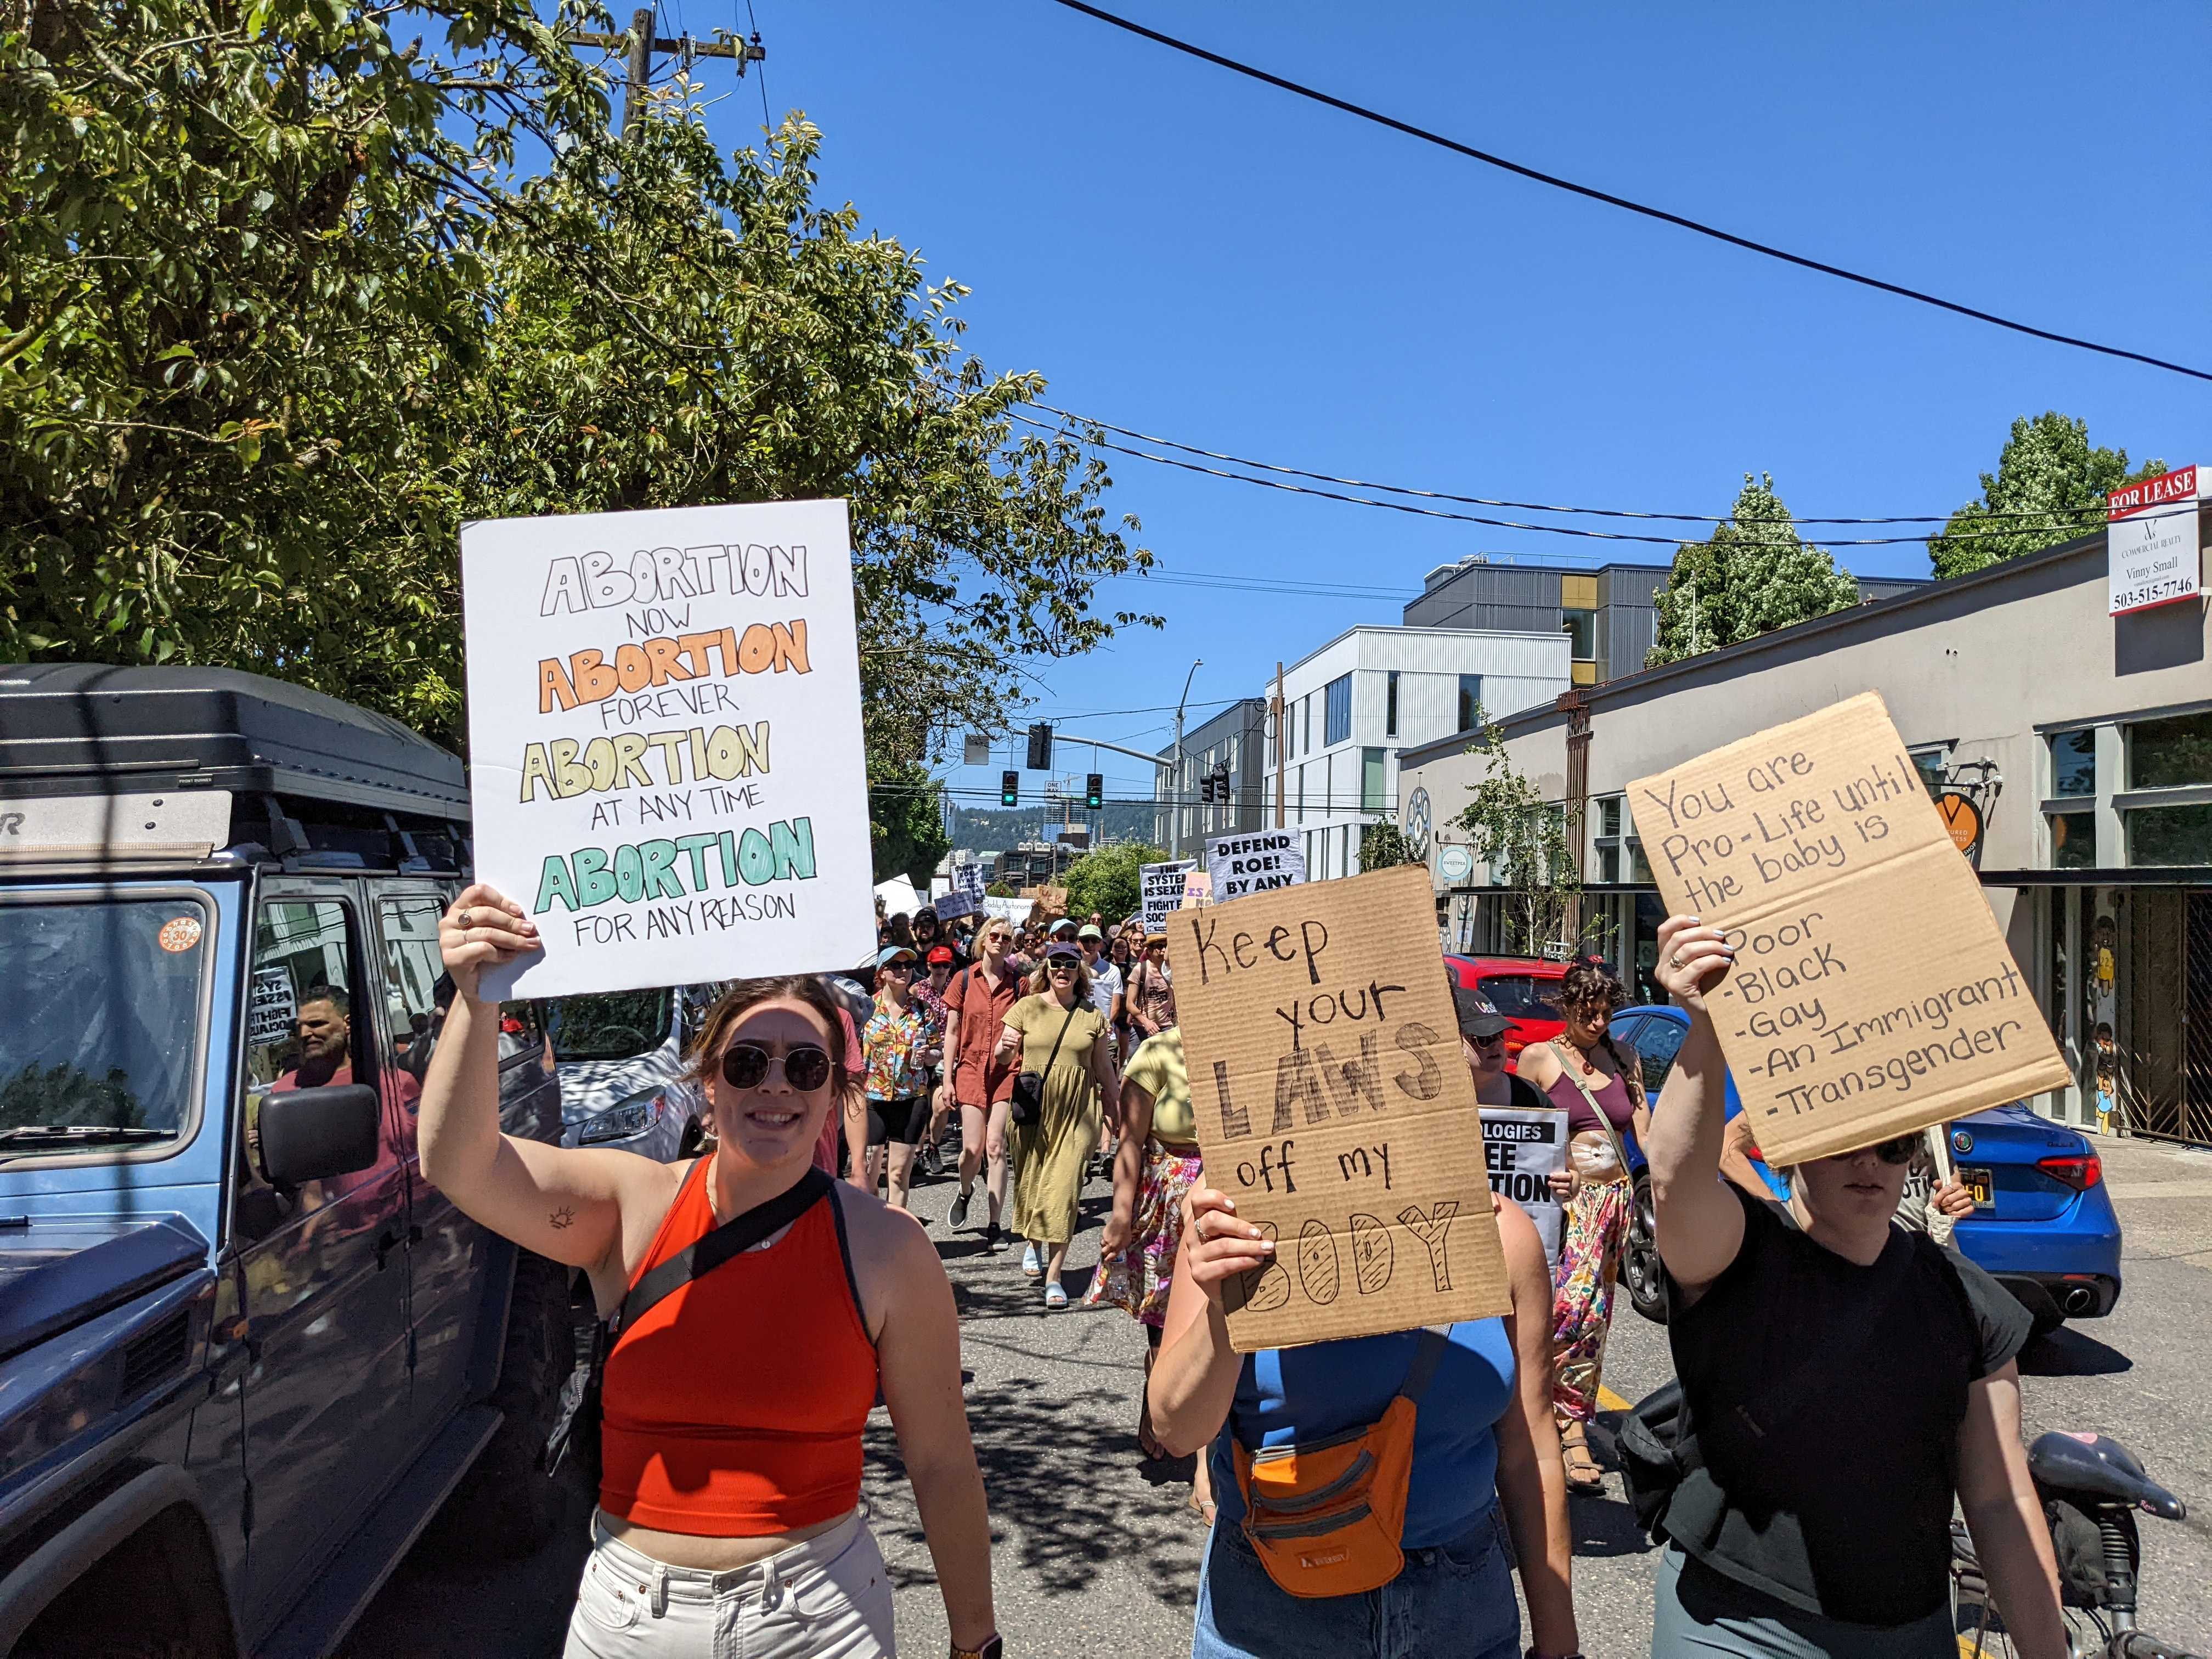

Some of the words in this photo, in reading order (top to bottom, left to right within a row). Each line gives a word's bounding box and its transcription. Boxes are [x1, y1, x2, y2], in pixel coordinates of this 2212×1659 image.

[2111, 490, 2139, 516] FOR
[2144, 471, 2193, 504] LEASE
[540, 544, 809, 617] ABORTION
[2126, 566, 2150, 580] Vinny
[2153, 556, 2177, 573] Small
[2114, 576, 2192, 609] 503-515-7746
[627, 603, 690, 638] NOW
[538, 619, 812, 713] ABORTION
[601, 684, 739, 730] FOREVER
[520, 721, 770, 803] ABORTION
[592, 799, 622, 830] AT
[641, 791, 692, 825] ANY
[700, 783, 765, 815] TIME
[1644, 780, 1735, 828] You
[1747, 752, 1814, 792] are
[0, 813, 26, 834] R
[1662, 798, 1825, 877] Pro-Life
[1832, 755, 1915, 811] until
[534, 816, 817, 915] ABORTION
[1218, 836, 1290, 856] DEFEND
[1232, 855, 1280, 874] ROE!
[1685, 874, 1743, 913] the
[1752, 835, 1846, 883] baby
[1854, 815, 1889, 843] is
[1963, 842, 1976, 855] SHOP
[1159, 864, 1180, 874] THE
[1226, 879, 1250, 894] BY
[1255, 873, 1293, 891] ANY
[984, 899, 1001, 911] Bodily
[1145, 887, 1155, 897] IS
[1148, 900, 1176, 911] FIGHT
[1187, 887, 1203, 897] IS
[173, 930, 187, 941] 30
[574, 913, 636, 946] FOR
[647, 900, 695, 939] ANY
[701, 893, 795, 930] REASON
[1723, 912, 1823, 967] Poor
[1191, 917, 1329, 985] Keep
[1276, 980, 1406, 1051] your
[1820, 961, 2019, 1054] Immigrant
[1214, 1022, 1442, 1139] LAWS
[1480, 1123, 1542, 1139] LOGIES
[1237, 1140, 1296, 1193] off
[1338, 1143, 1391, 1189] my
[1484, 1143, 1517, 1171] EE
[1488, 1173, 1551, 1203] TION
[1241, 1201, 1459, 1312] BODY
